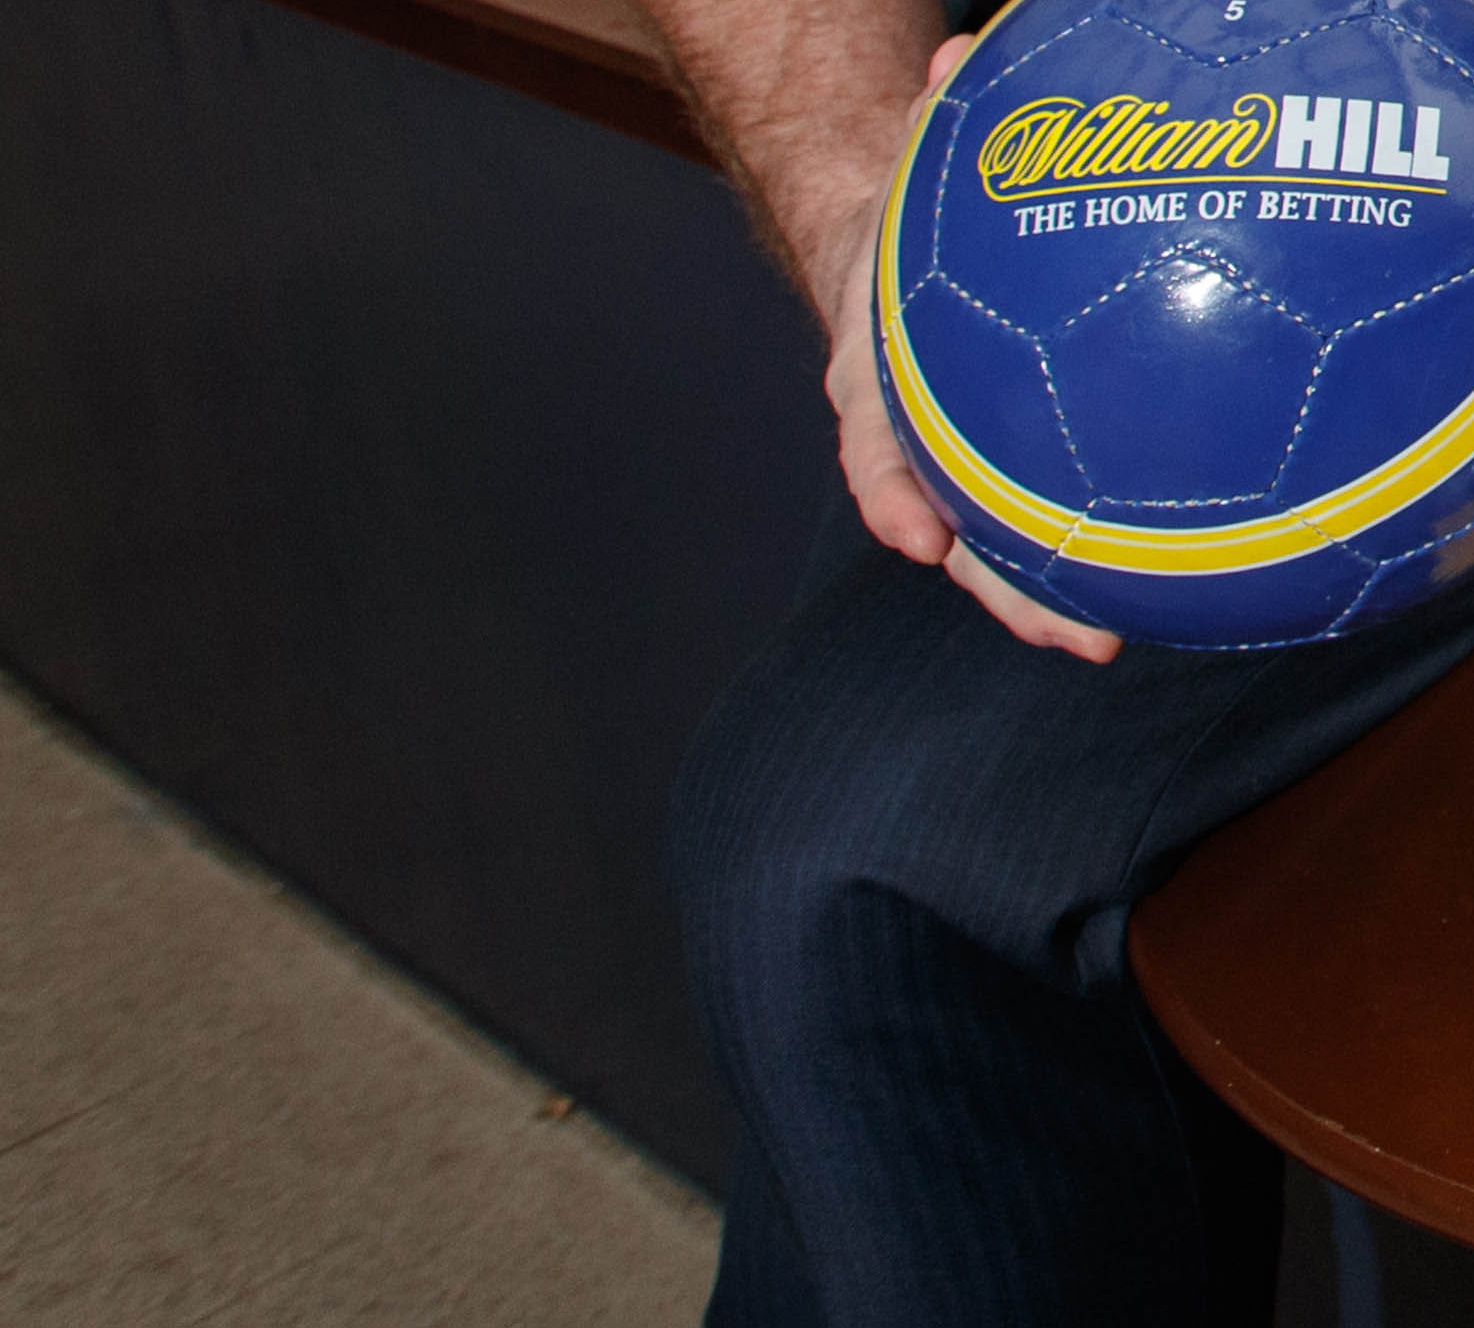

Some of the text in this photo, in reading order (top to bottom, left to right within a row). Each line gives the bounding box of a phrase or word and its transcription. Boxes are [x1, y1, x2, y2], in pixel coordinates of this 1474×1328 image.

[1223, 0, 1247, 21] 5
[977, 93, 1450, 191] William HILL
[1014, 190, 1414, 238] THE HOME OF BETTING
